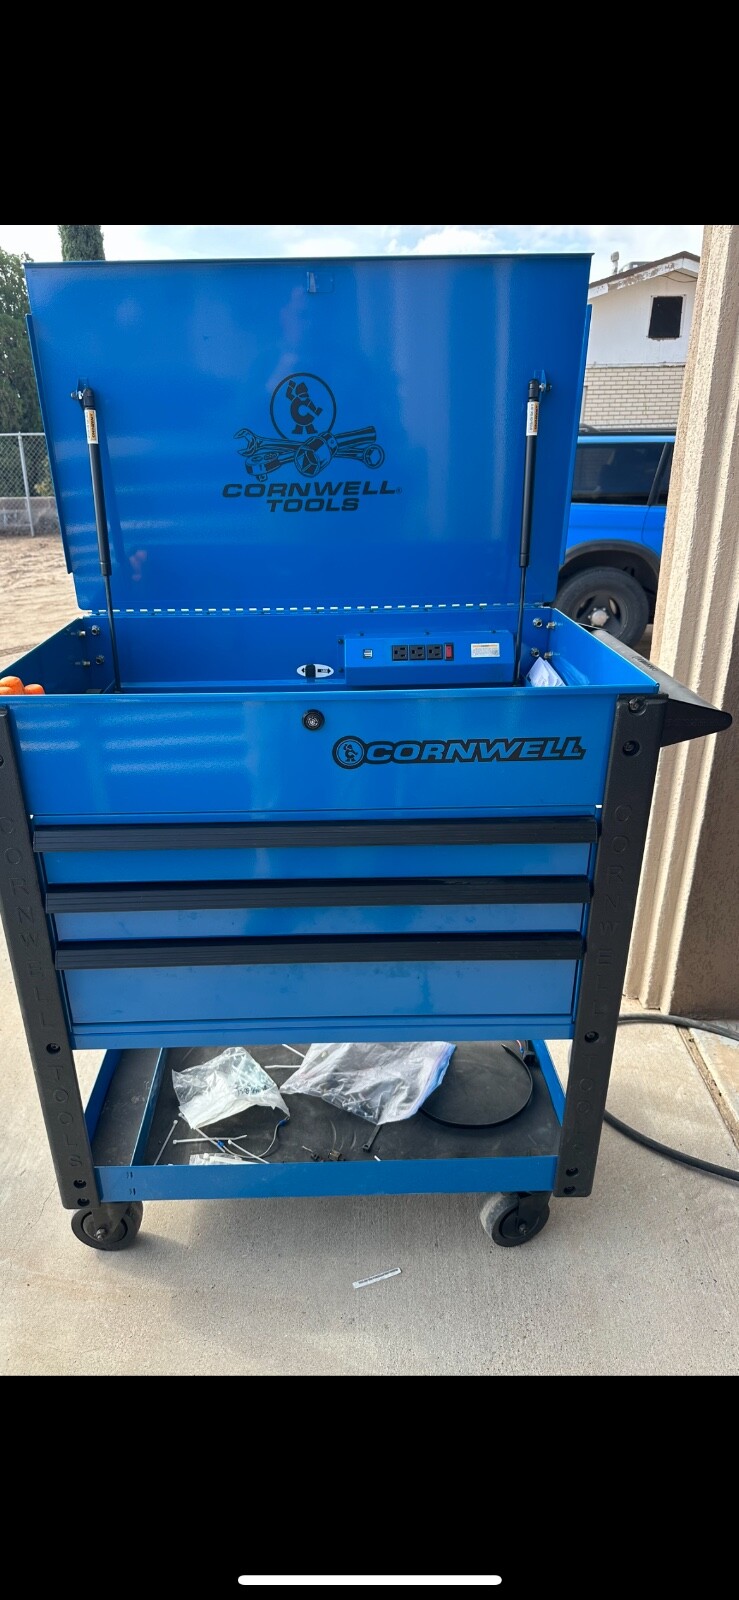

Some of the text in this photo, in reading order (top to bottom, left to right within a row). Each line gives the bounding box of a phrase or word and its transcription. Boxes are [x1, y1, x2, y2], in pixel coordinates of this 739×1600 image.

[222, 480, 396, 498] CORNWELL
[266, 498, 360, 512] TOOLS
[366, 742, 582, 762] CORNWELL
[50, 1065, 84, 1167] TOOLS
